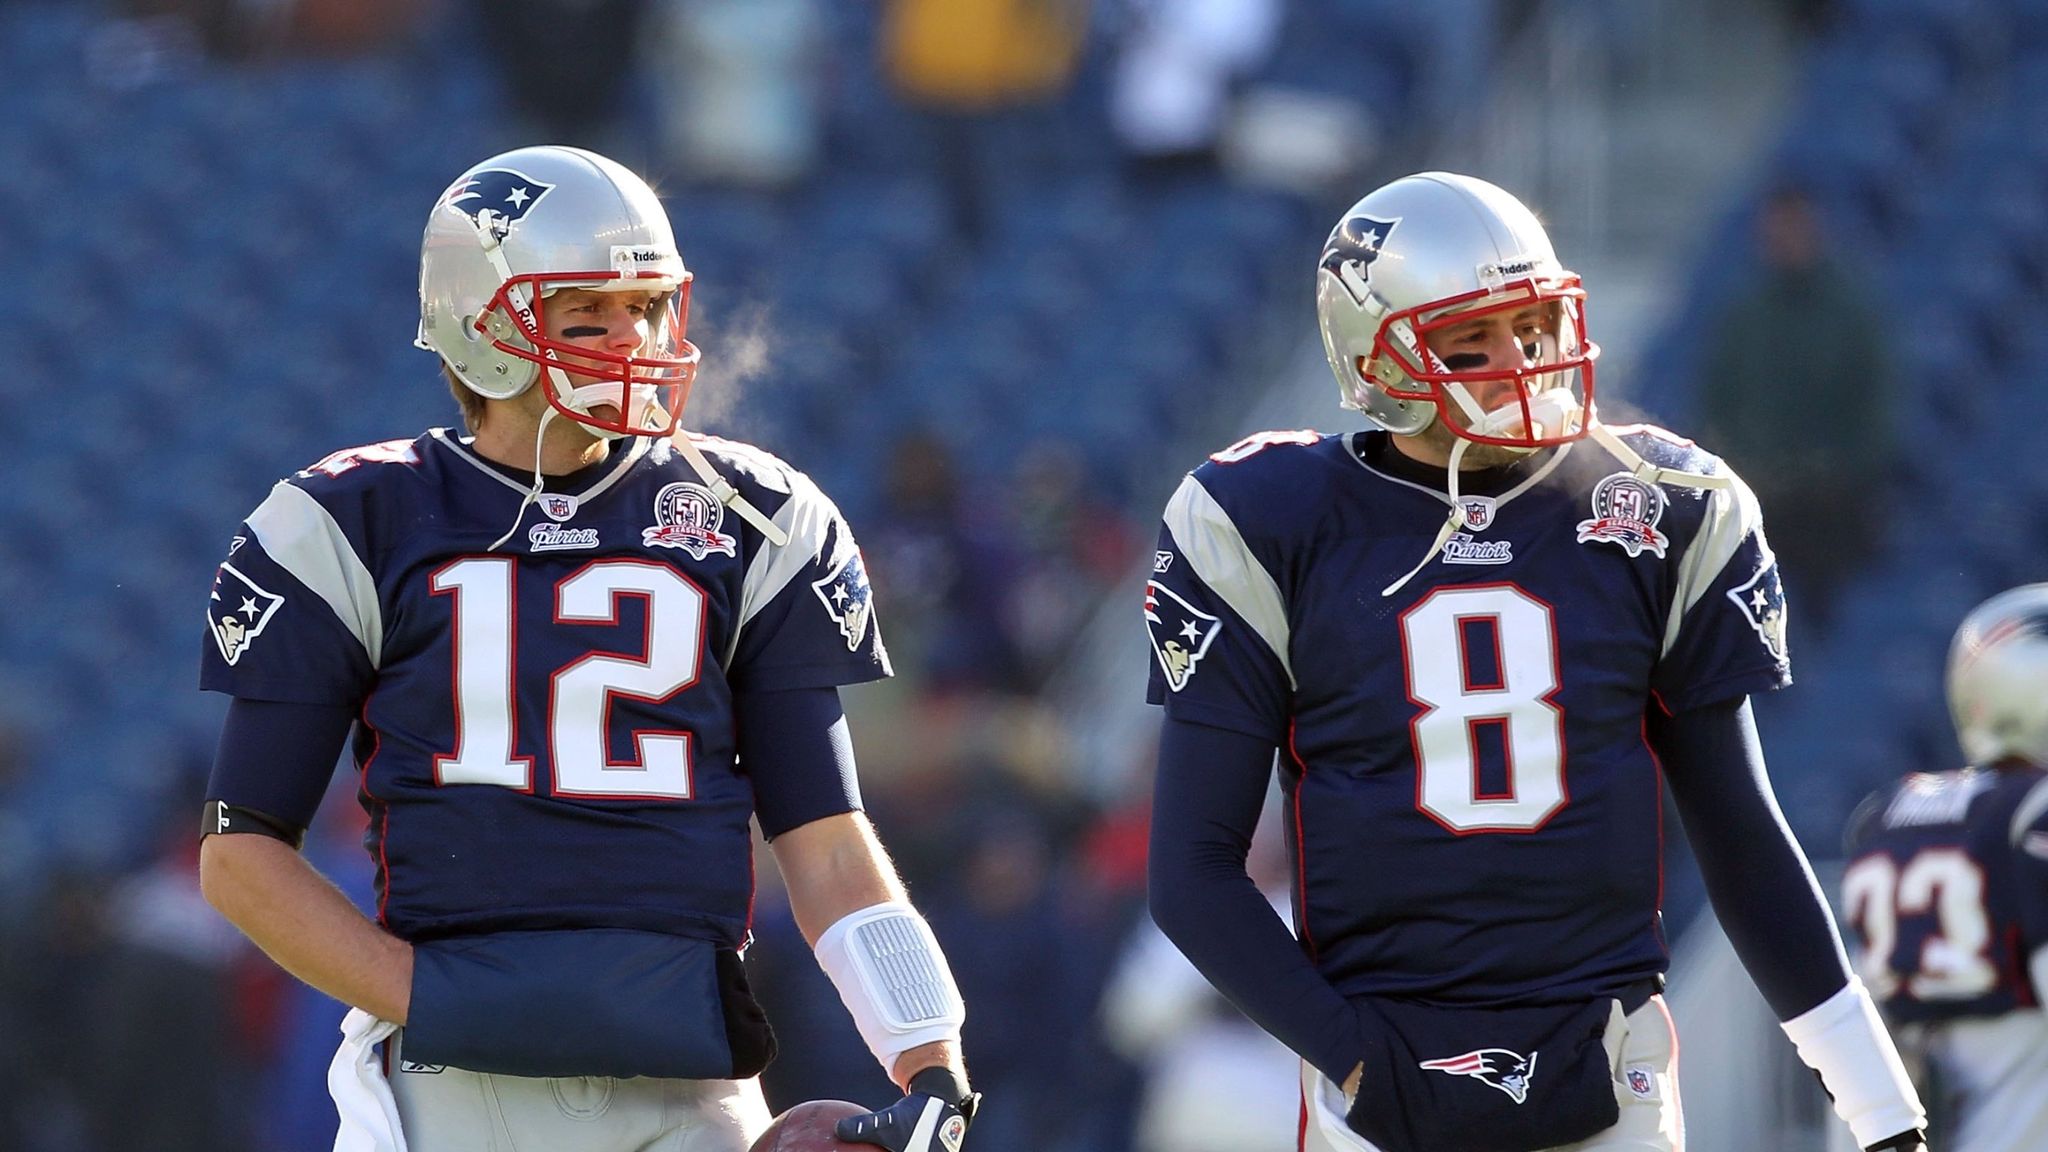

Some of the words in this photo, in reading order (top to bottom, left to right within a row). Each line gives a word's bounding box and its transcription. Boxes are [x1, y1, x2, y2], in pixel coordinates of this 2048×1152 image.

[675, 496, 704, 527] 50
[1613, 488, 1641, 520] 50
[531, 527, 597, 550] Patriots
[670, 526, 709, 538] SEASONS
[1606, 518, 1645, 533] SEASONS
[1443, 540, 1511, 562] Patriots
[428, 554, 708, 801] 12
[1396, 580, 1570, 836] 8
